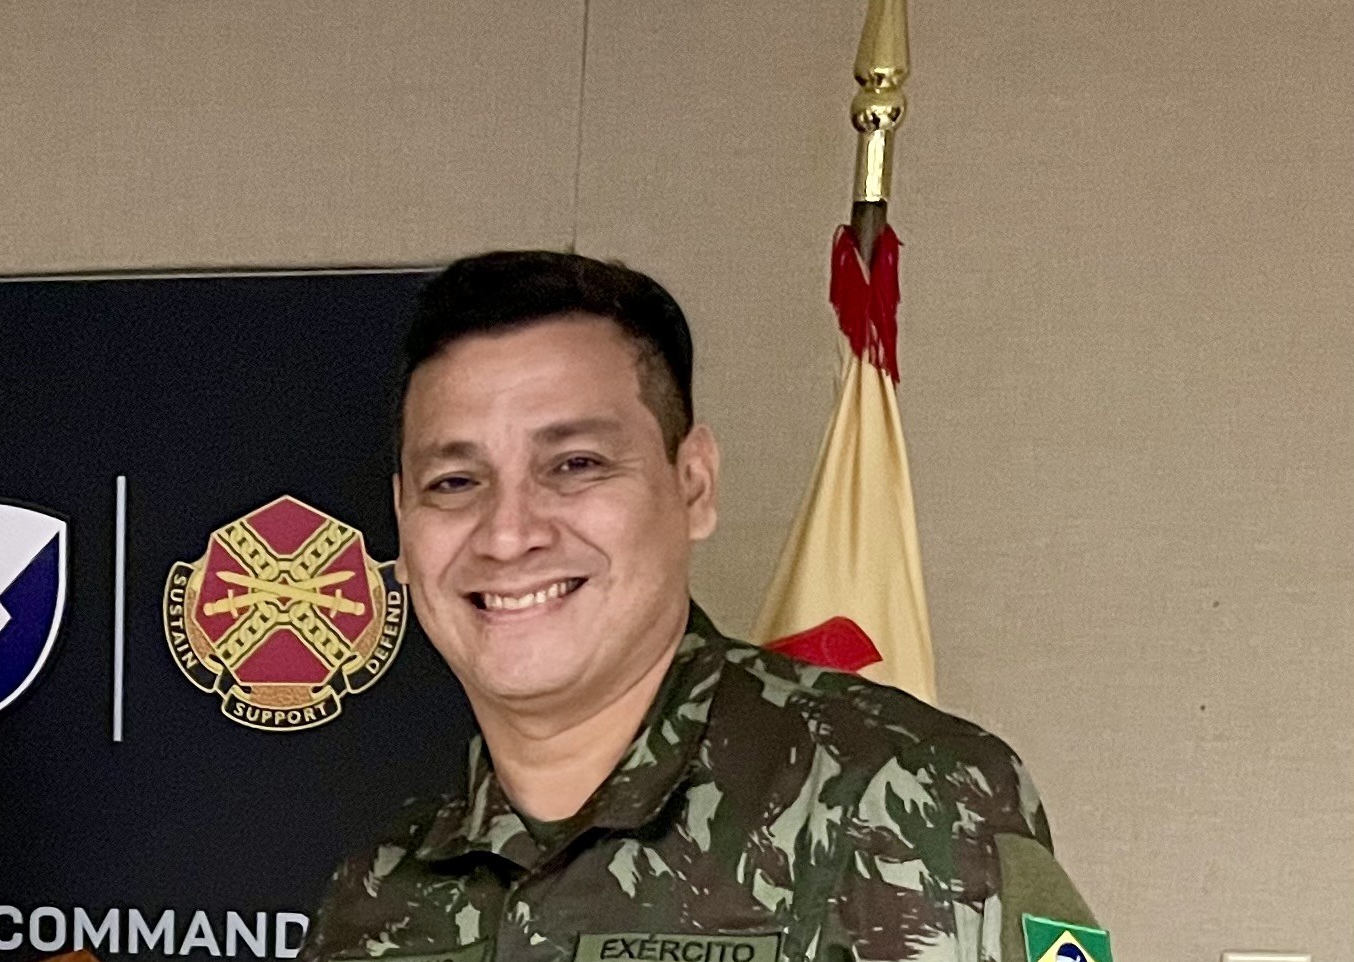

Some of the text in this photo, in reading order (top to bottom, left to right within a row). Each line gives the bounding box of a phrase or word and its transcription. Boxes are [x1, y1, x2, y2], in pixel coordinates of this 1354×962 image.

[169, 574, 198, 670] SUSTAIN
[365, 590, 402, 675] DEFEND
[233, 702, 328, 725] SUPPORT
